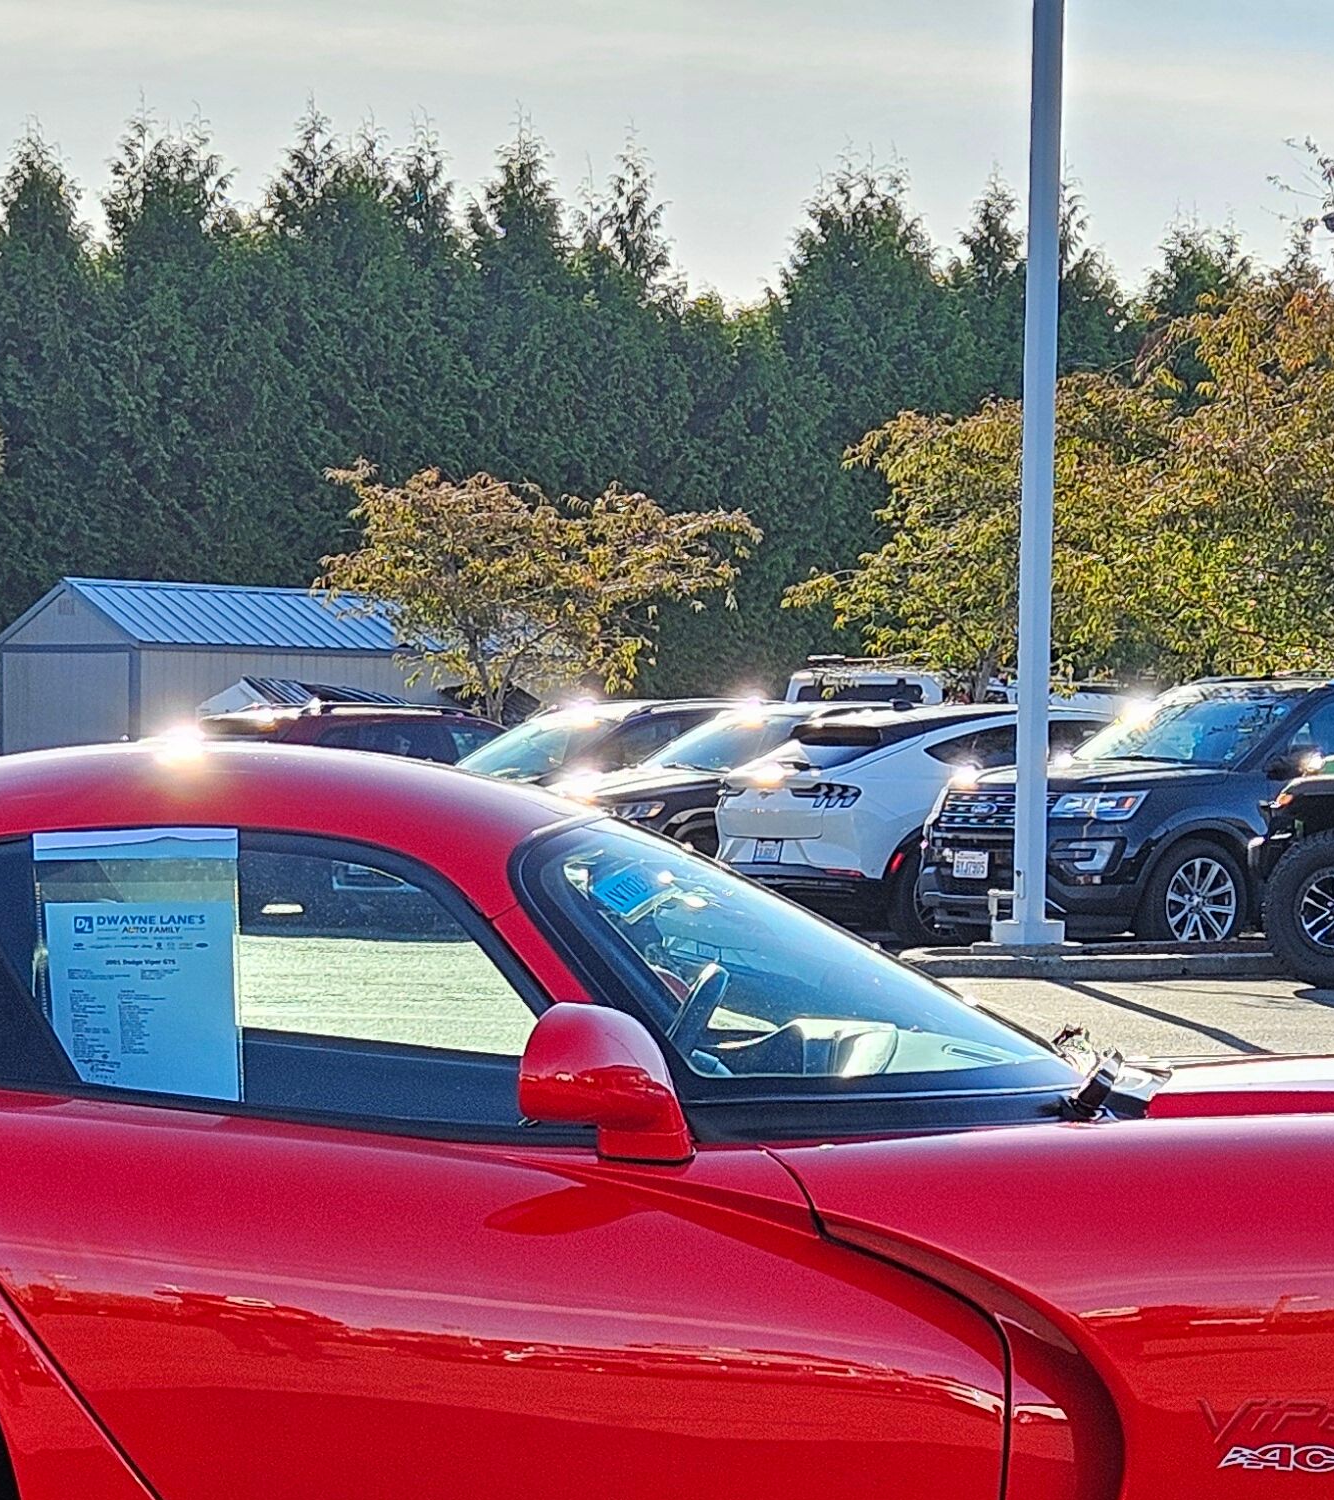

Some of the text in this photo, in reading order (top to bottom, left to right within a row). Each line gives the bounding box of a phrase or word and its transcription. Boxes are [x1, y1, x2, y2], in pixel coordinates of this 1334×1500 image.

[97, 914, 206, 925] DWAYNE LANE'S
[149, 926, 181, 934] FAMILY
